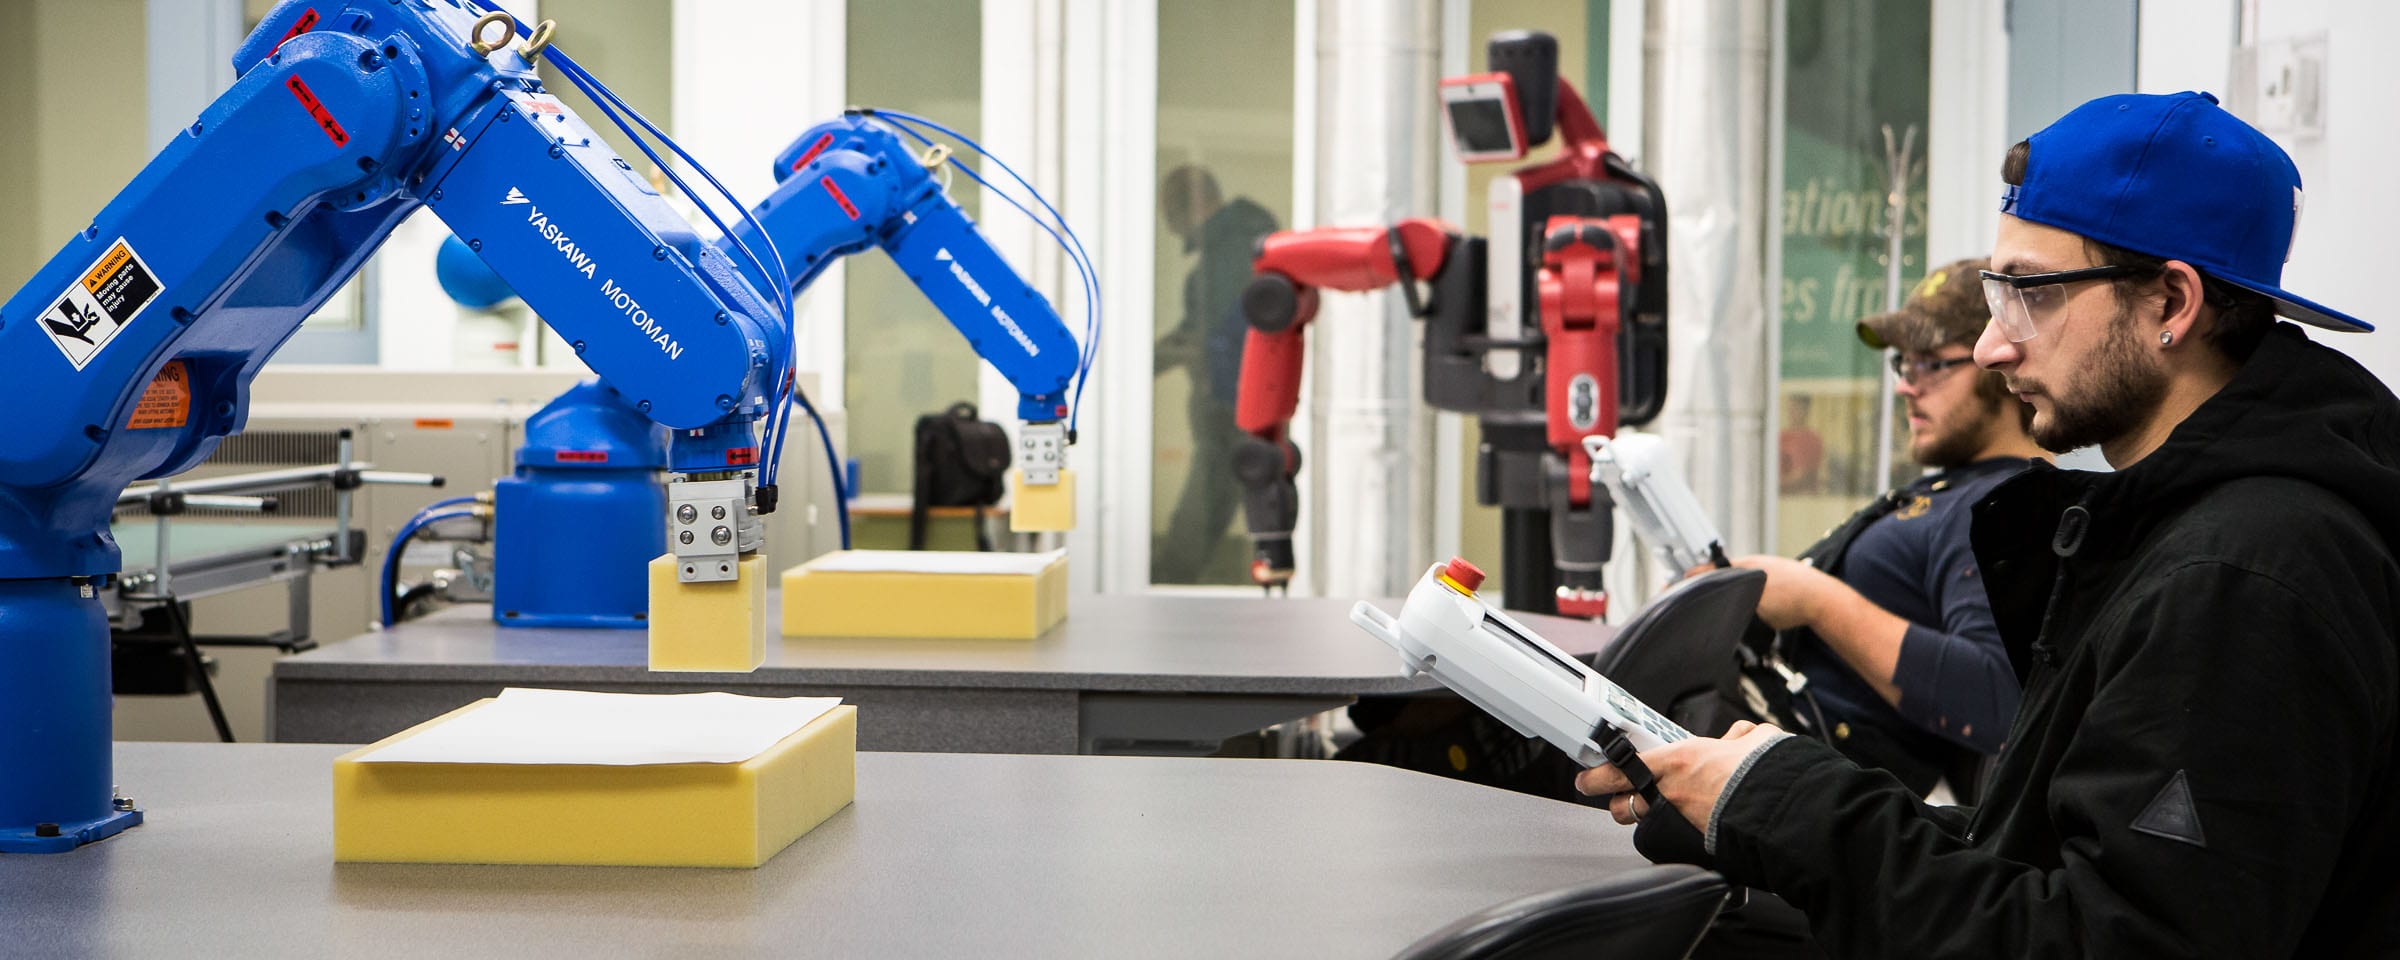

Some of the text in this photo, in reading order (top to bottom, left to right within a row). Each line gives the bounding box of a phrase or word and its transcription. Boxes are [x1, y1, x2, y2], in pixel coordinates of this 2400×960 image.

[95, 250, 127, 280] WARNING
[96, 263, 134, 300] Moving parts
[102, 275, 134, 307] may cause
[527, 205, 684, 361] YASKAWA MOTOMAN
[107, 294, 125, 313] injury
